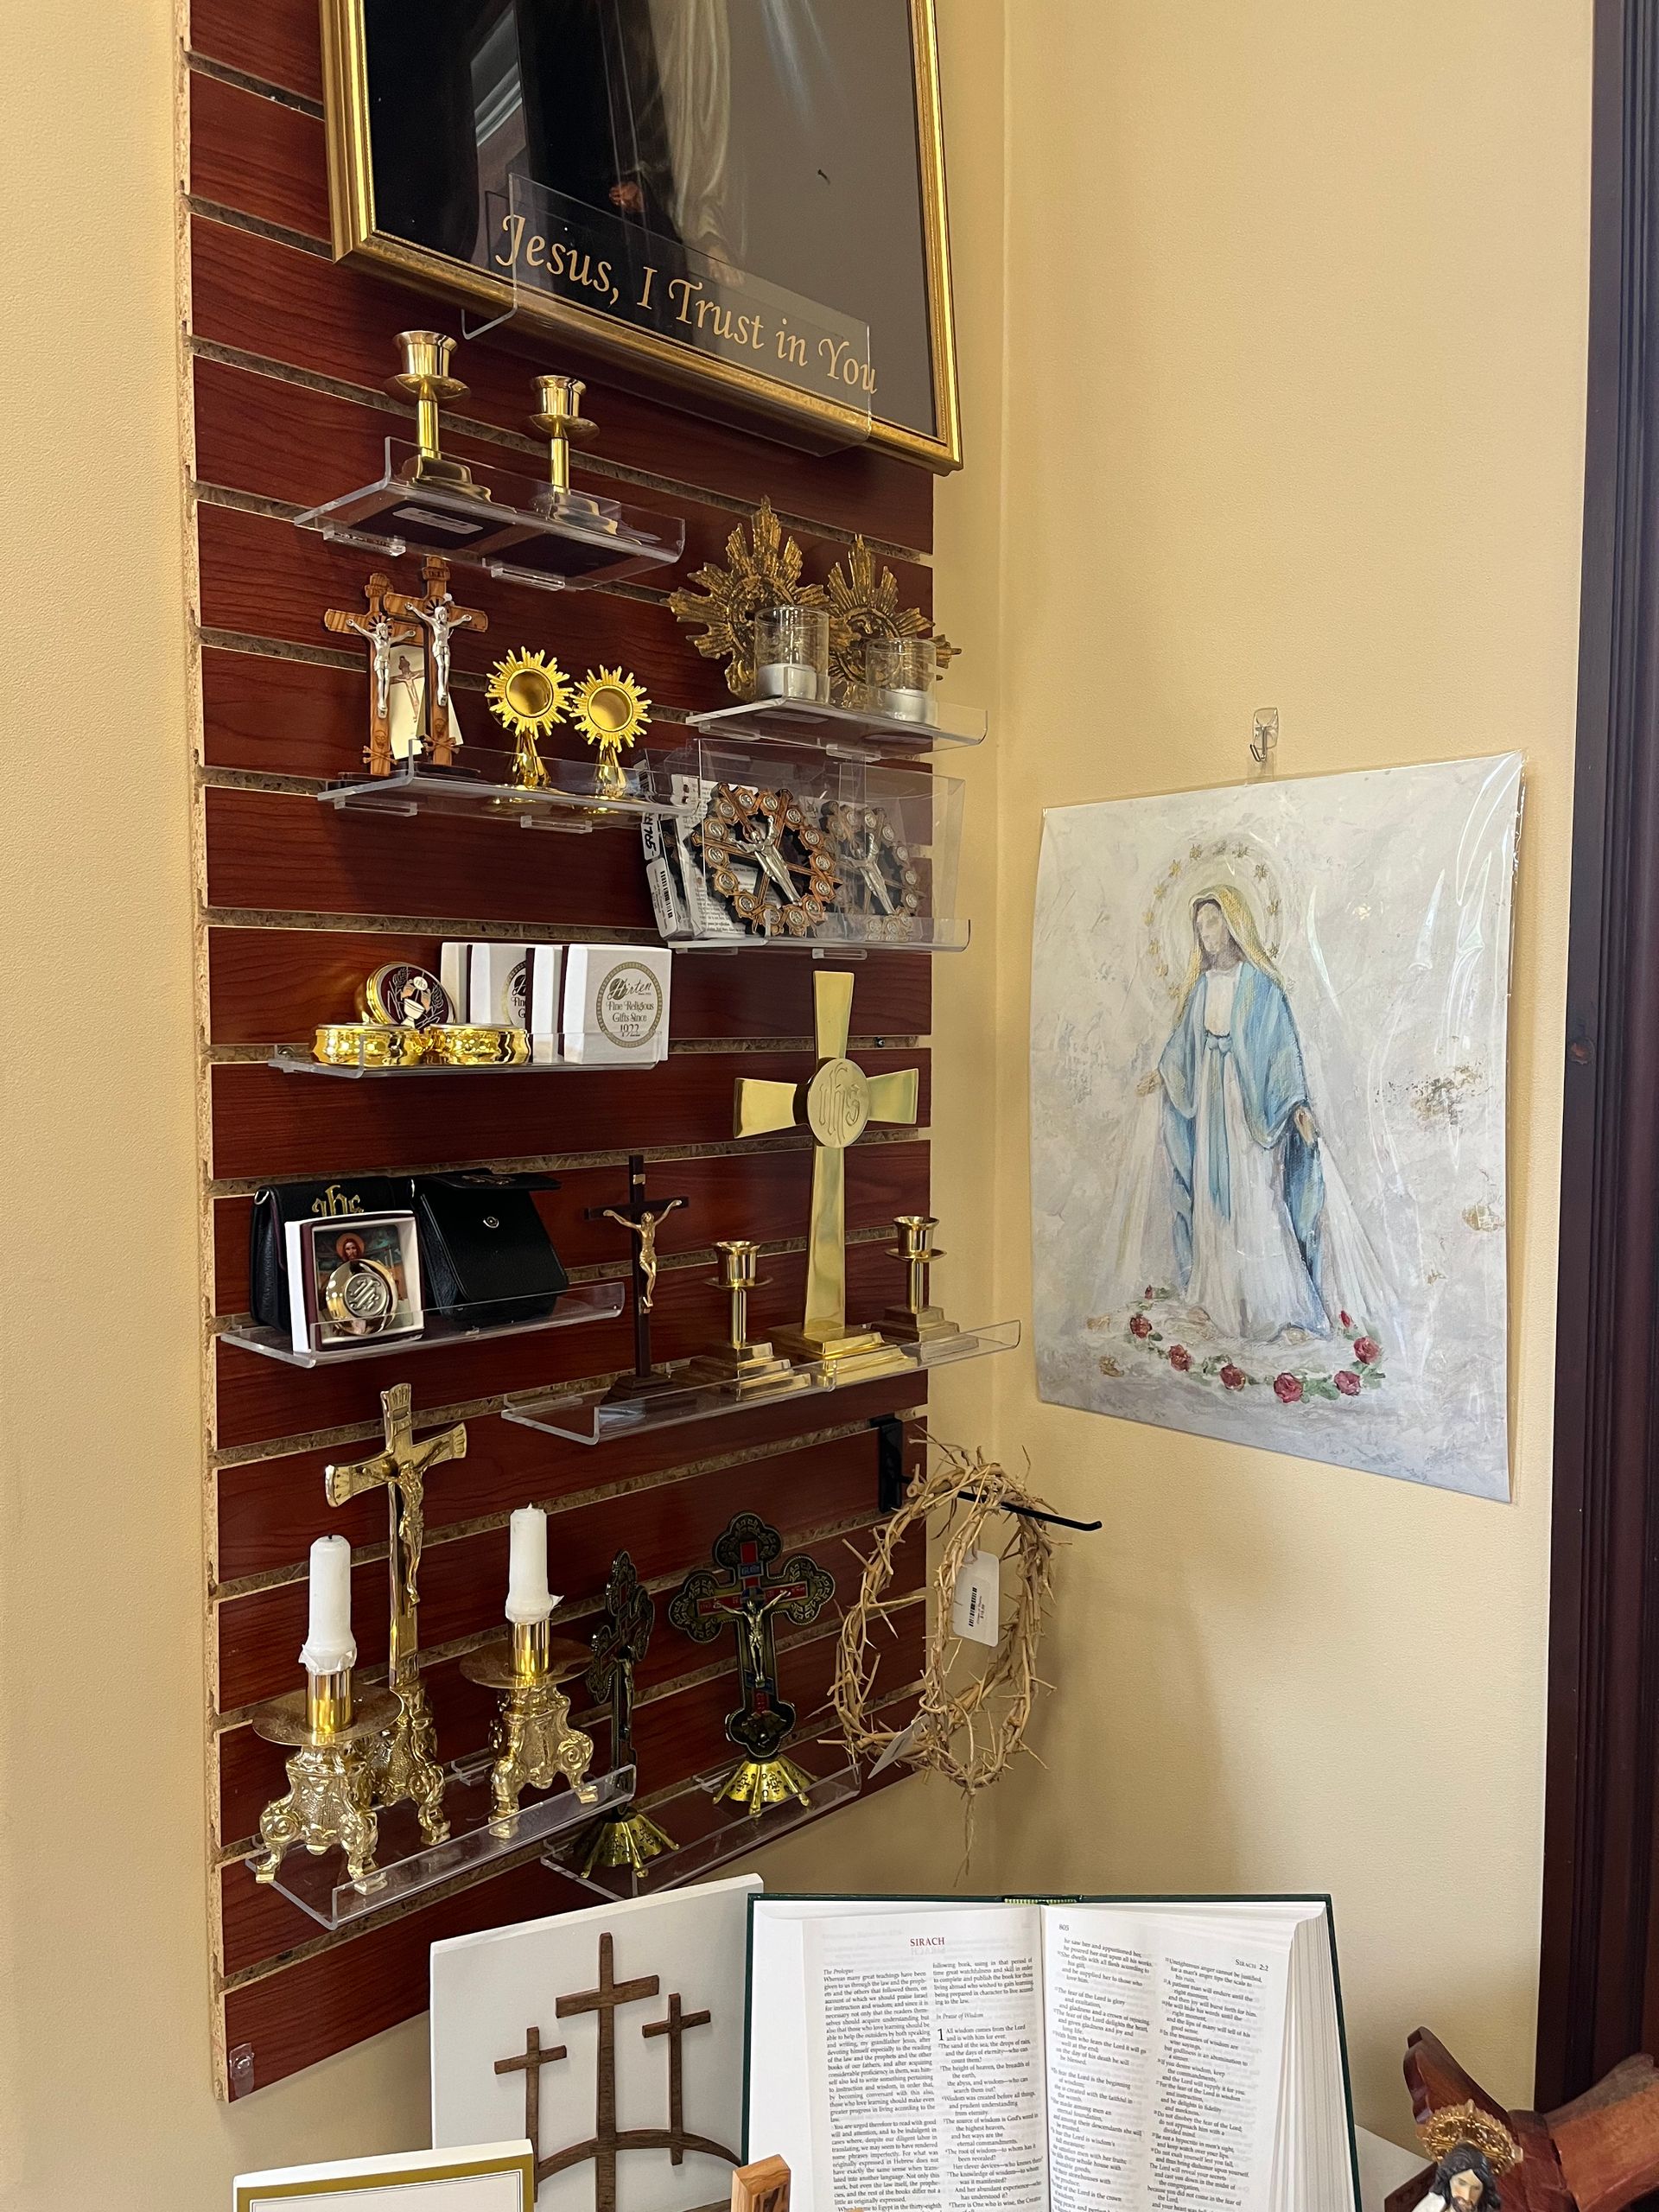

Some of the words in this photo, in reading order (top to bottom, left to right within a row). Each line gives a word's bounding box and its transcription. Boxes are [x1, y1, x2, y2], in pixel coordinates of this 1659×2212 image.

[495, 214, 620, 306] Jesus,
[637, 266, 658, 310] I
[669, 277, 765, 350] Trust
[776, 317, 808, 367] in
[817, 337, 878, 395] You
[511, 996, 526, 1007] Fin
[607, 1001, 623, 1012] Fine
[624, 1001, 654, 1012] Religious
[612, 1012, 630, 1022] Gifts
[630, 1012, 647, 1022] Since
[620, 1023, 640, 1037] 1922
[910, 1936, 944, 1947] SIRACH
[938, 2029, 945, 2042] 1
